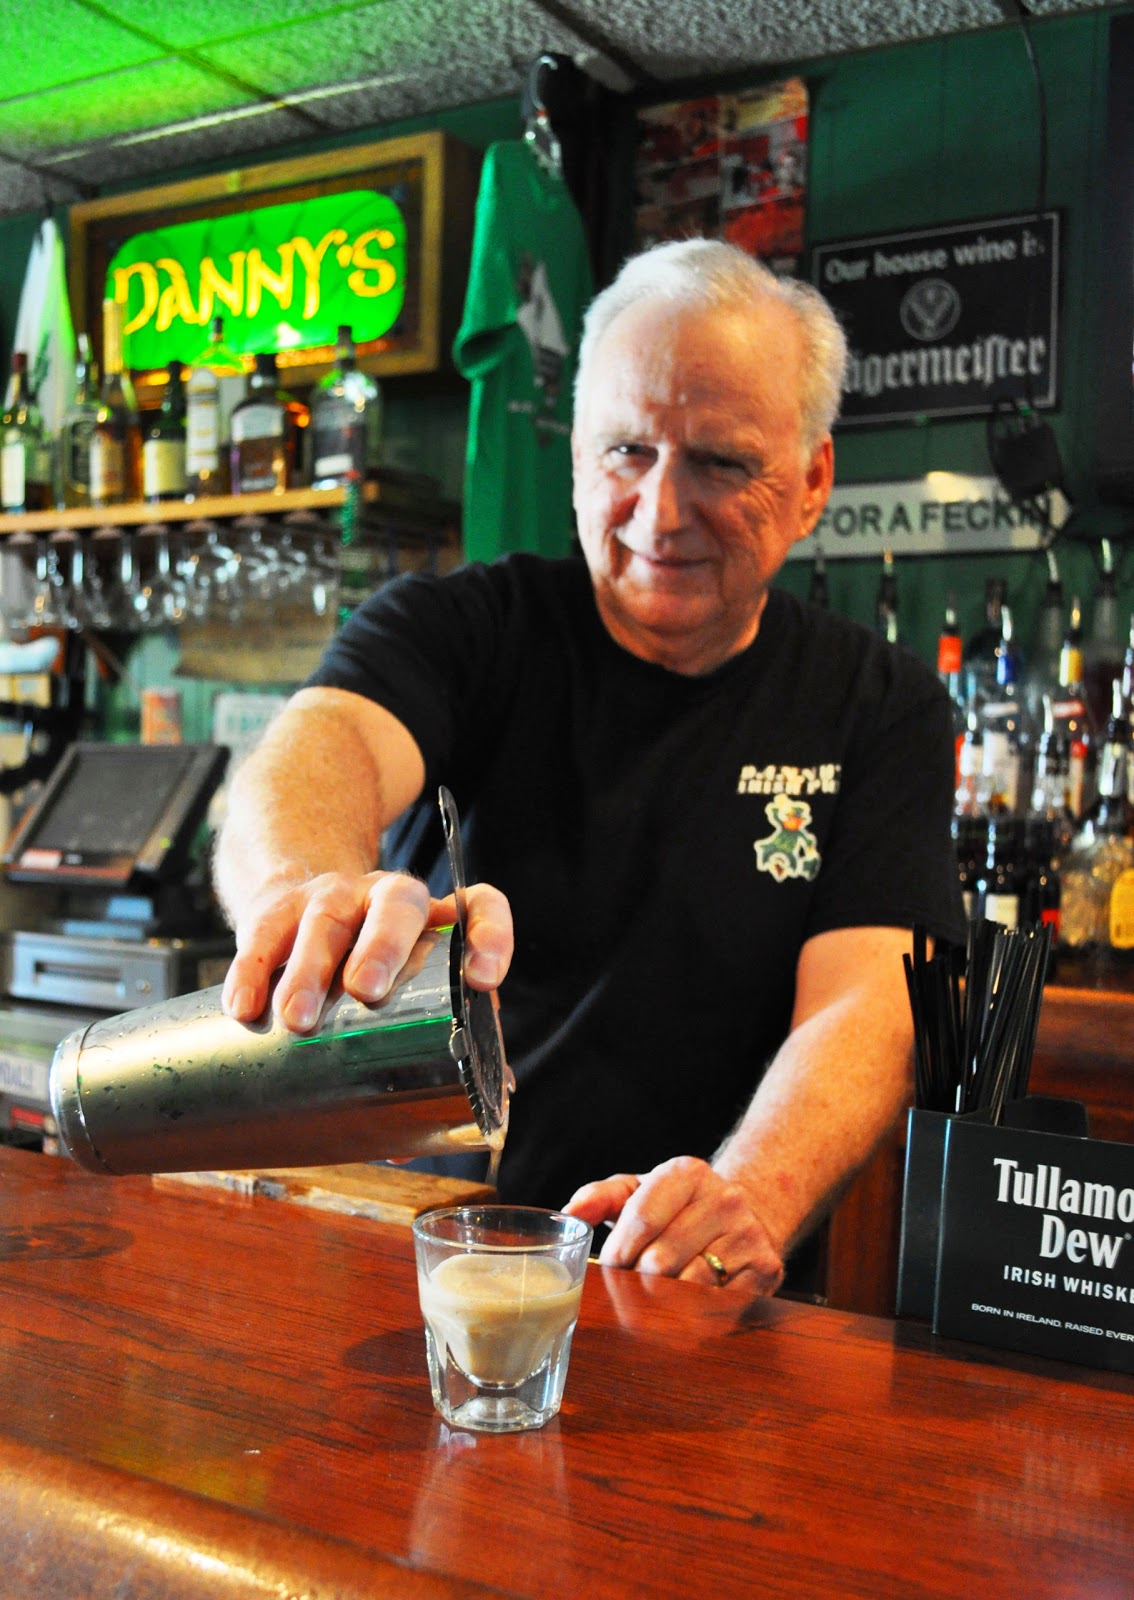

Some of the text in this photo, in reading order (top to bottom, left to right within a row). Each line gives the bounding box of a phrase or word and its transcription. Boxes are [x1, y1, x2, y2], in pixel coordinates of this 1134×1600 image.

[113, 229, 397, 335] DANNY'S
[824, 258, 870, 284] Our
[873, 250, 948, 277] house
[953, 235, 1017, 266] wine
[889, 503, 912, 535] A
[993, 1157, 1134, 1223] Tullamo
[1039, 1214, 1124, 1270] Dew
[1003, 1265, 1056, 1289] IRISH
[971, 1303, 1001, 1316] BORN
[1003, 1309, 1014, 1318] IN
[1065, 1321, 1104, 1336] RAISED
